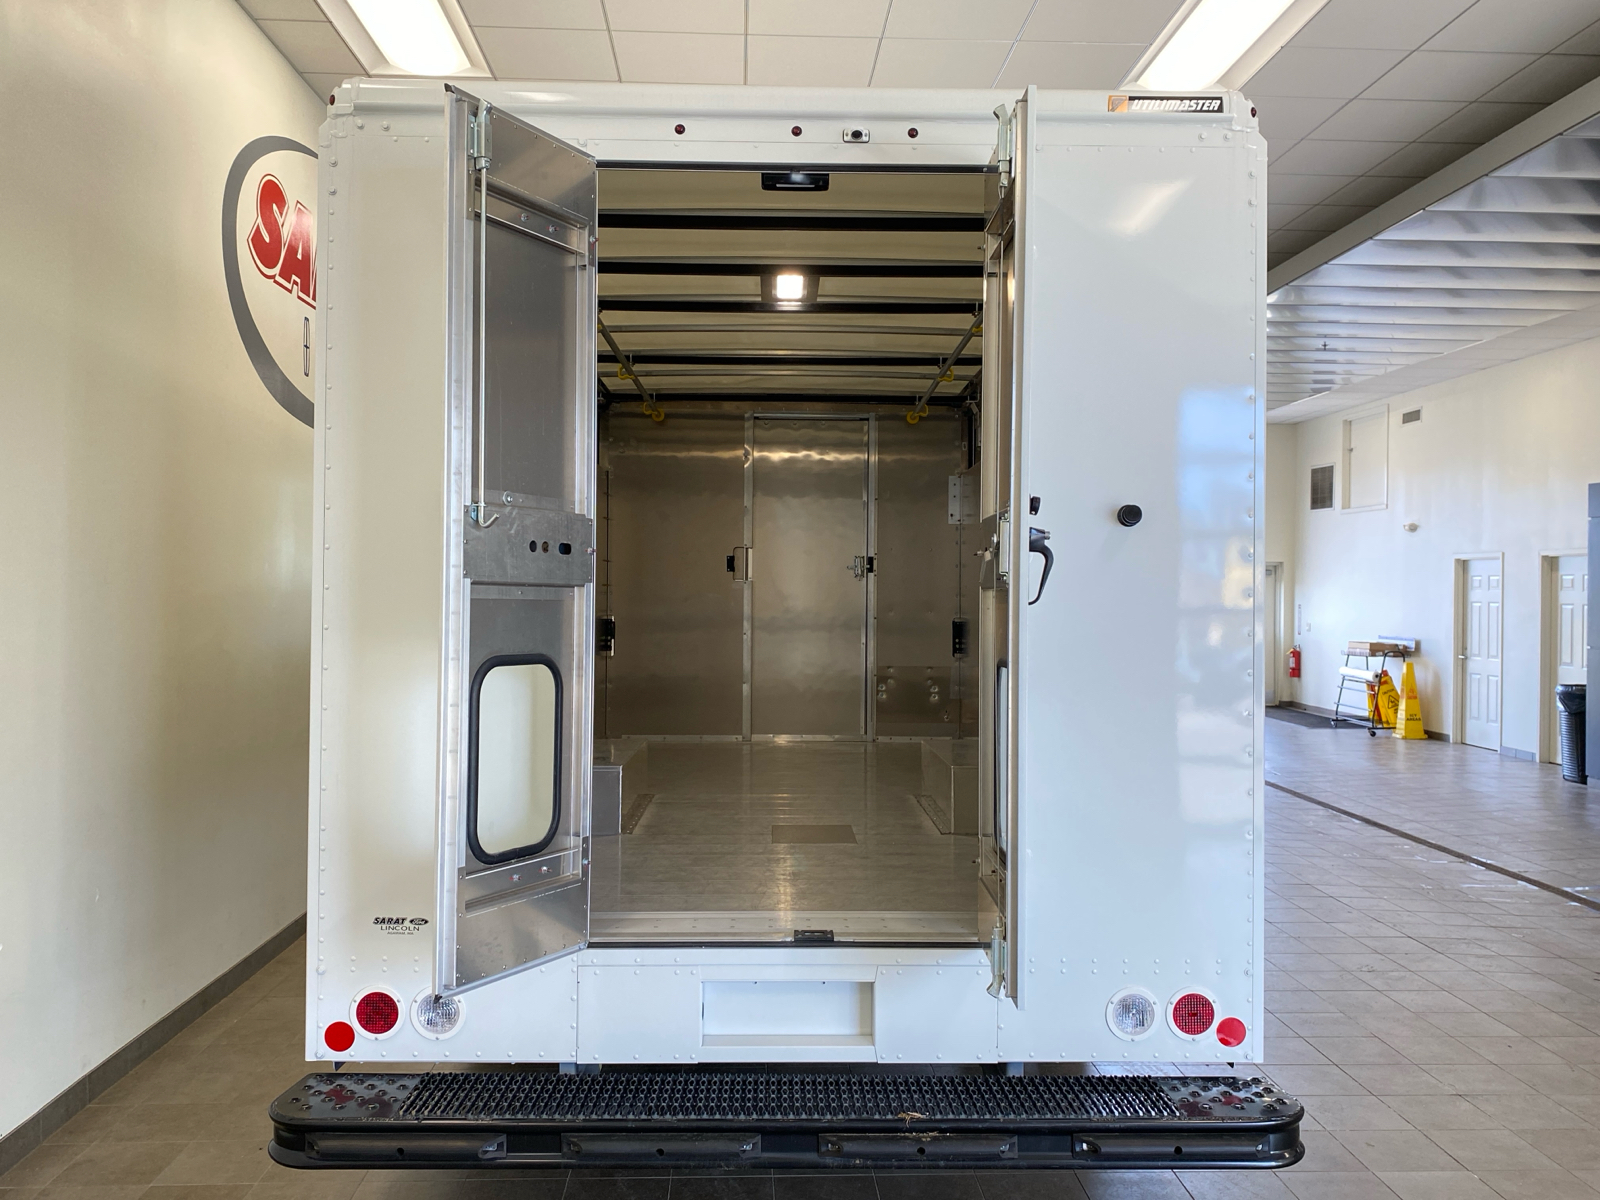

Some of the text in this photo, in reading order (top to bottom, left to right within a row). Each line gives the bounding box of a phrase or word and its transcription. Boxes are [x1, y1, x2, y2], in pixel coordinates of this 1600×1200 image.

[1132, 99, 1221, 111] UTILIMASTER
[247, 173, 316, 310] SA
[373, 917, 407, 925] SARAT
